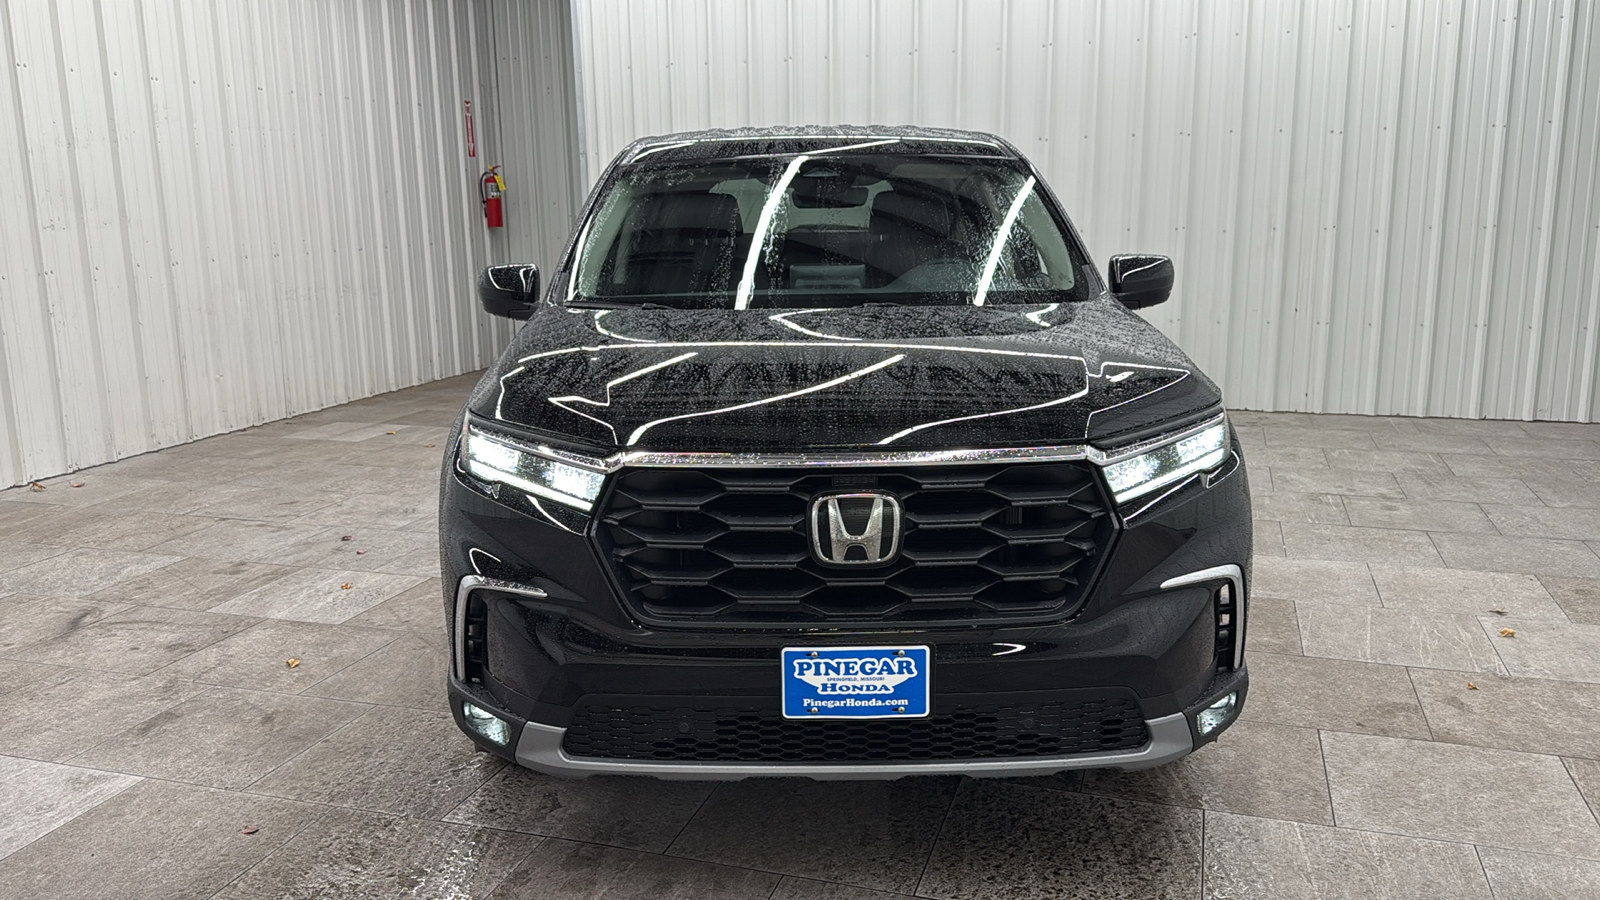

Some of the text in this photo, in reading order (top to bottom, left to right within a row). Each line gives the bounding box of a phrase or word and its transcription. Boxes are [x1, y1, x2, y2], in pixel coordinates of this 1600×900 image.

[827, 497, 883, 562] H
[796, 660, 915, 676] PINEGAR
[820, 683, 892, 692] HONDA
[803, 698, 908, 708] PinegarHonda.com
